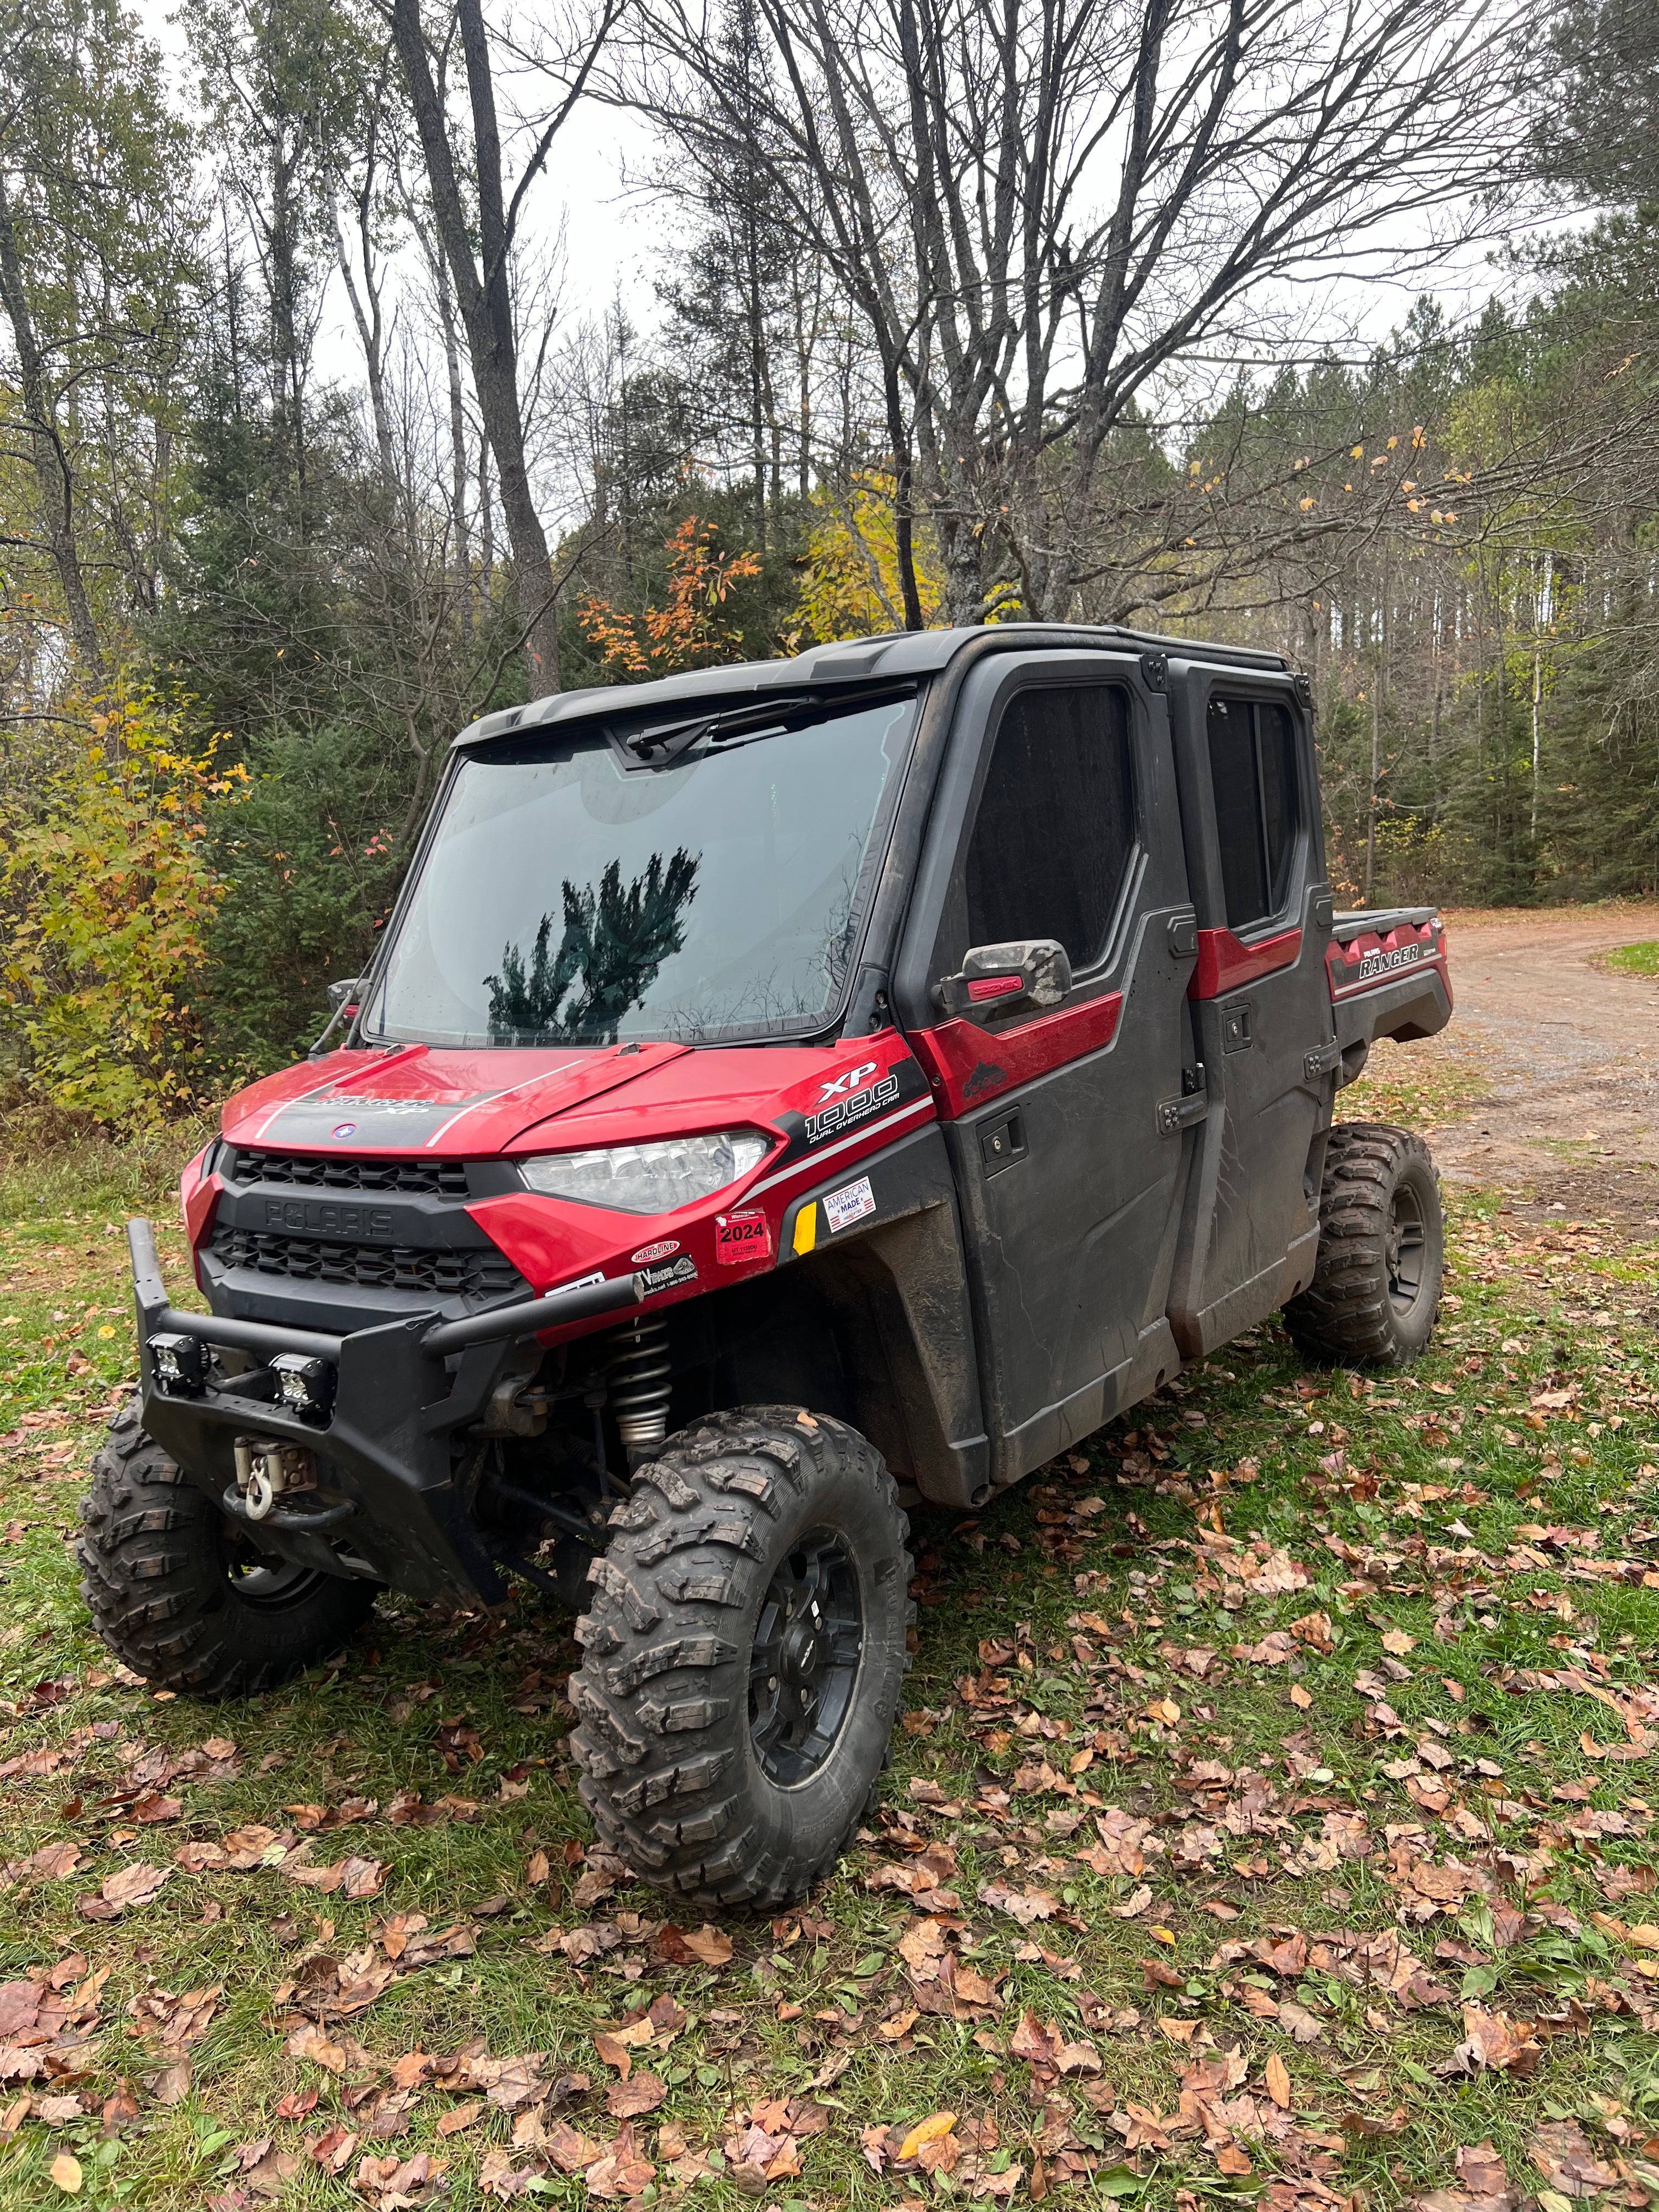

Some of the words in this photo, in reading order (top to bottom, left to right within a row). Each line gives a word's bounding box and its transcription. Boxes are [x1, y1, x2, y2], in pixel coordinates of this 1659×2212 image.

[1359, 944, 1418, 979] RANGER
[974, 979, 1019, 995] SEIZMIK
[818, 1062, 878, 1104] XP
[312, 1098, 435, 1108] RANGER
[805, 1074, 898, 1138] 1000
[809, 1128, 834, 1144] DUAL
[836, 1103, 881, 1130] OVERHEAD
[882, 1092, 900, 1106] CAM
[828, 1181, 869, 1210] AMERICAN
[840, 1197, 860, 1213] MADE
[266, 1201, 393, 1237] POLARIS
[720, 1222, 764, 1243] 2024
[637, 1242, 674, 1260] HARDLINE
